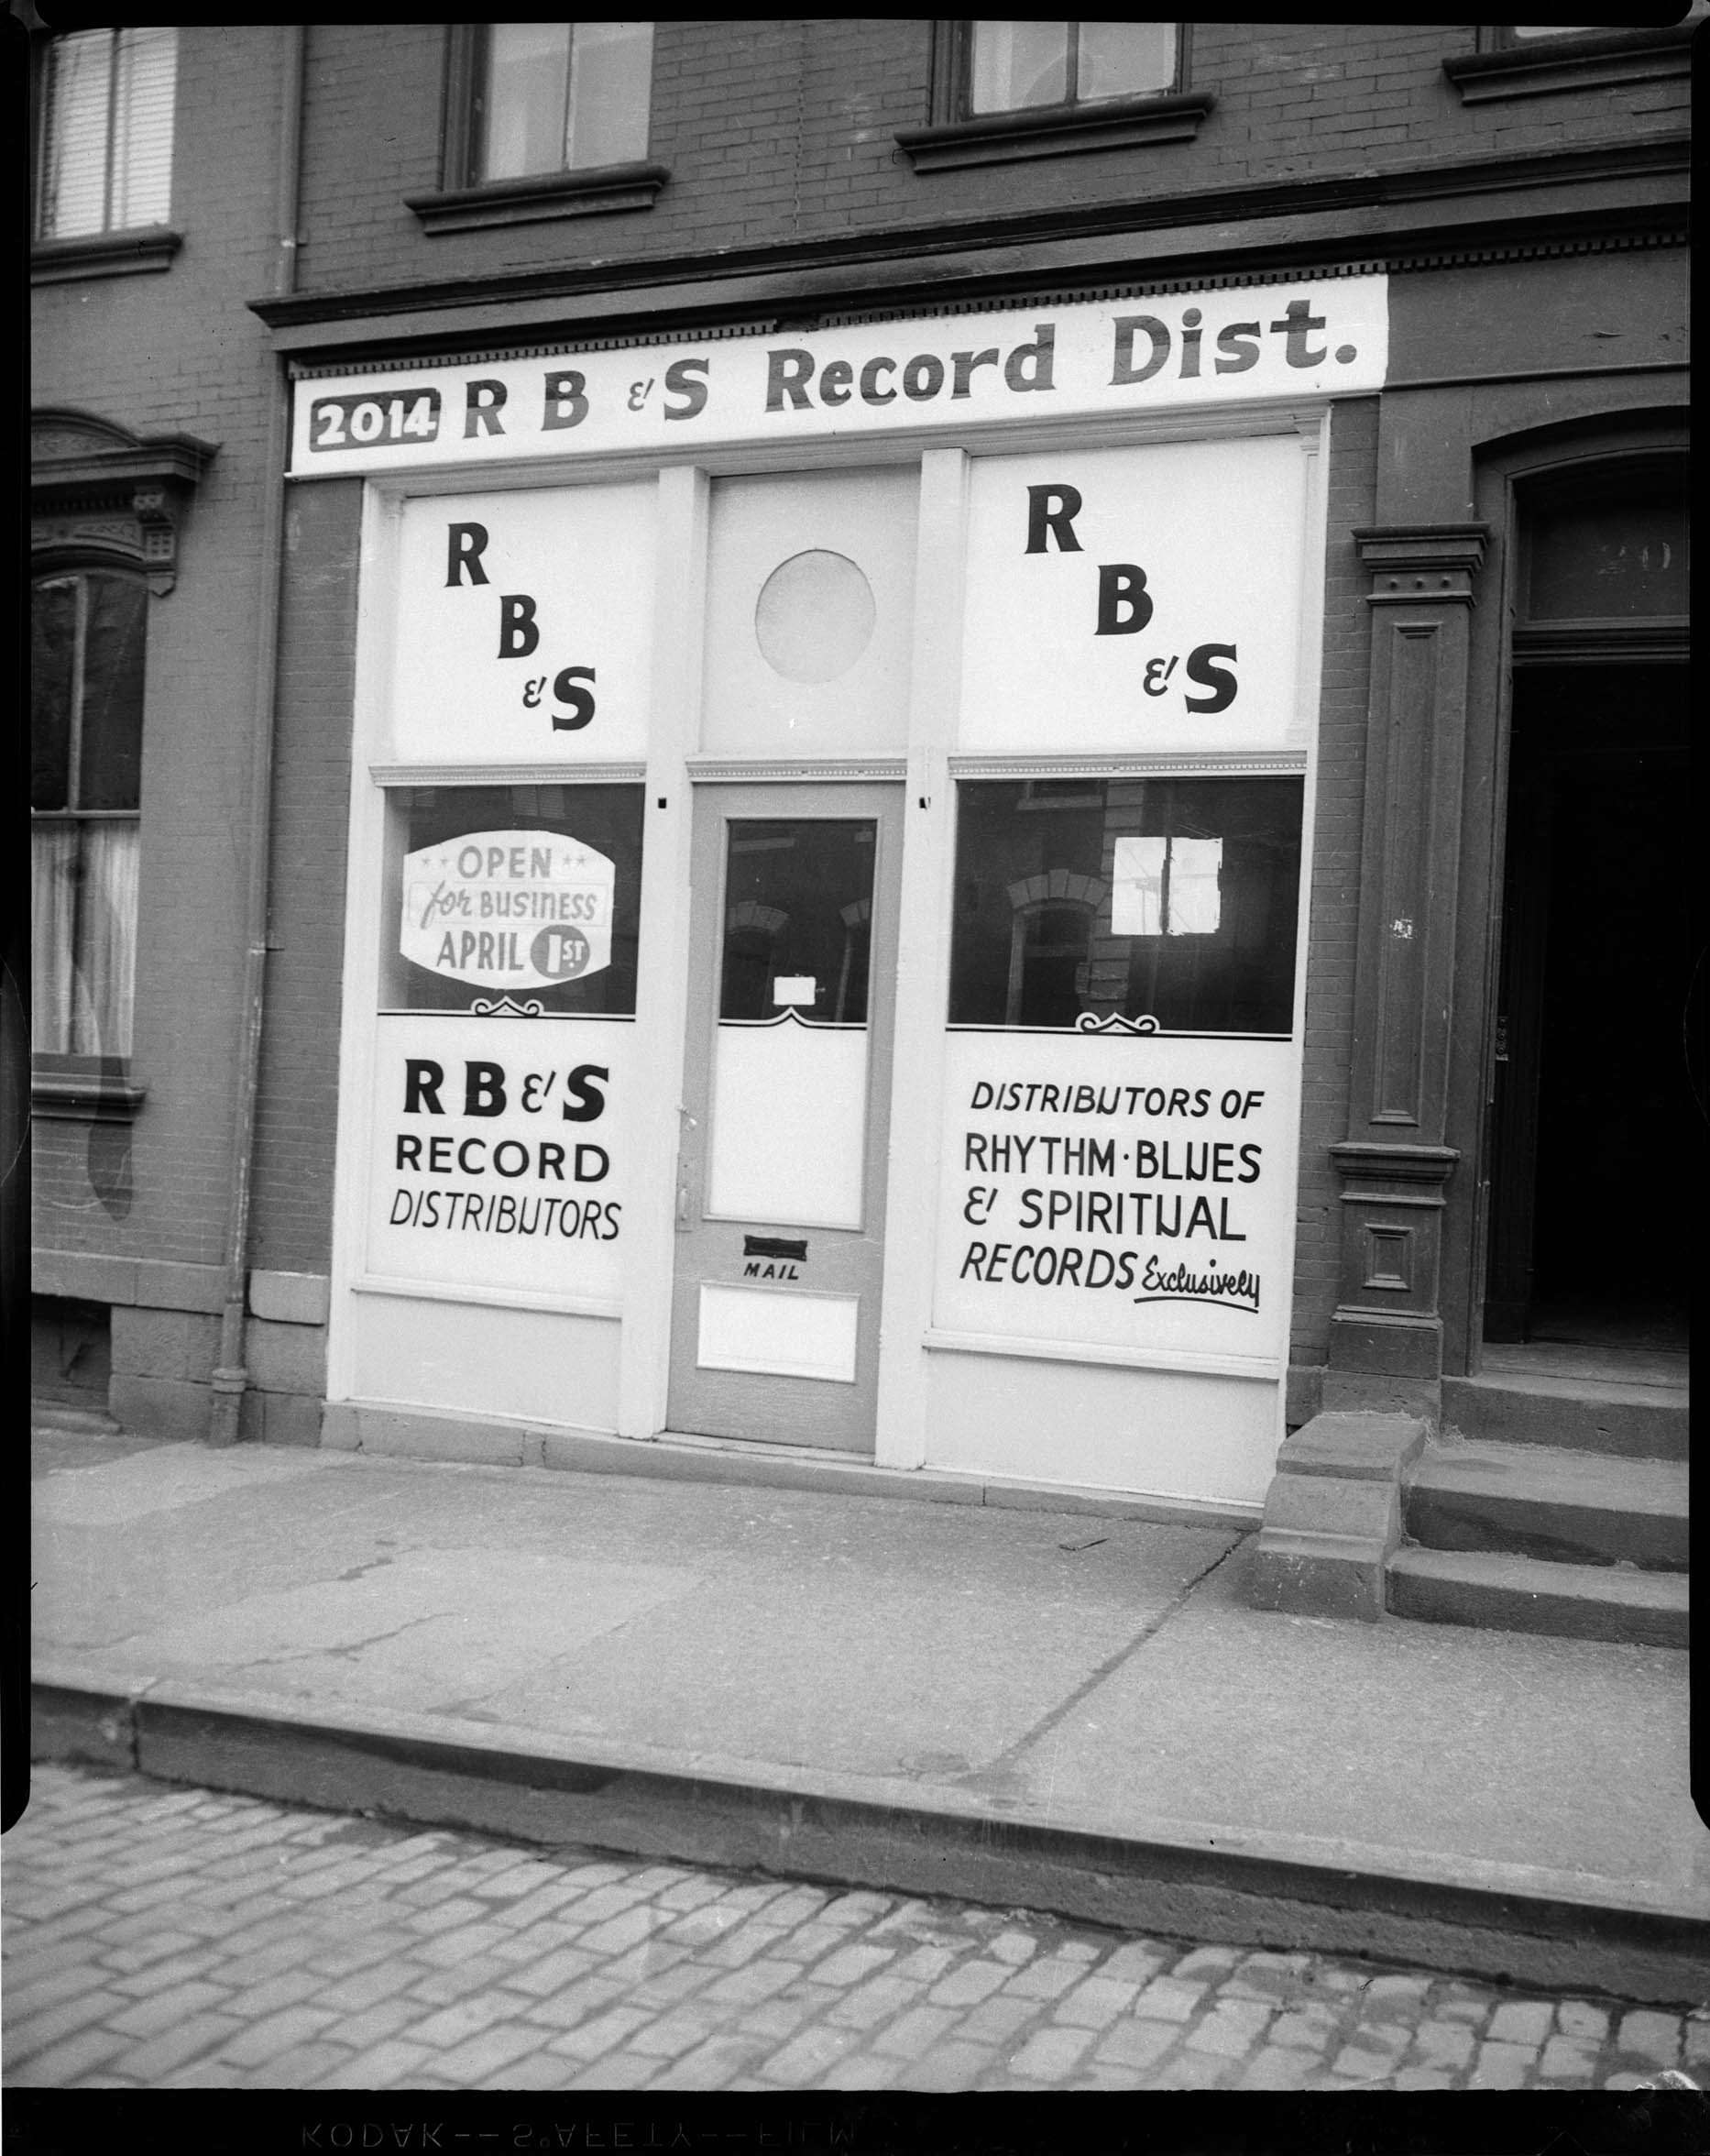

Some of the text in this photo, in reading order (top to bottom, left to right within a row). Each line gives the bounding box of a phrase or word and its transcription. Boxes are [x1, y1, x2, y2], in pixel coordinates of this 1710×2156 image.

[318, 398, 437, 446] 2014
[766, 324, 1055, 412] Record
[1109, 300, 1356, 385] Dist.
[1025, 484, 1083, 554] R
[445, 522, 490, 587] R
[499, 594, 539, 658] B
[1095, 565, 1153, 635] B
[457, 845, 553, 879] OPEN
[420, 880, 597, 930] for BUSINESS
[435, 930, 525, 971] APRIL
[971, 1082, 1266, 1119] DISTRIBUTORS OF
[396, 1135, 610, 1182] RECORD
[389, 1189, 622, 1241] DISTRIBUTORS
[964, 1186, 1246, 1242] & SPIRITUAL
[744, 1262, 799, 1280] MAIL
[960, 1242, 1260, 1308] RECORDS Exclusively
